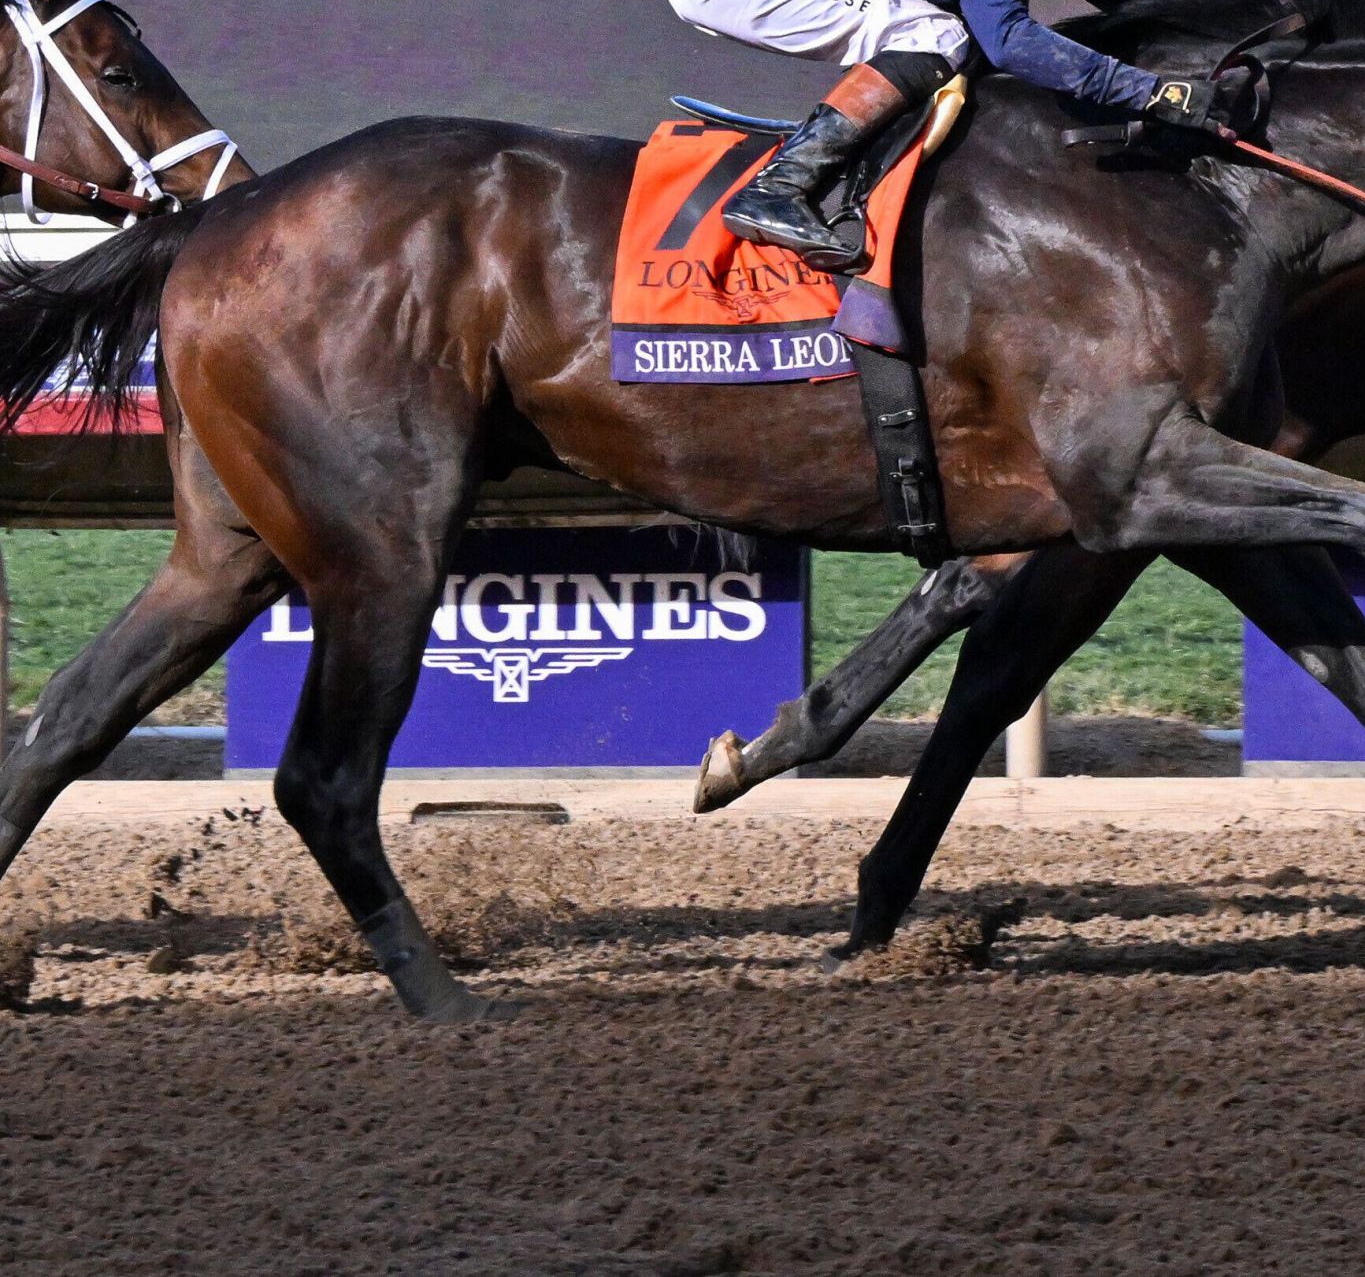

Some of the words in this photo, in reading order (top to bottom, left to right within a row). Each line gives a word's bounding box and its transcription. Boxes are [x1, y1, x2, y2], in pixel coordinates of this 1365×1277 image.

[654, 124, 782, 251] 7
[637, 257, 834, 296] LONGINE
[635, 339, 761, 374] SIERRA
[262, 571, 767, 642] LGINES
